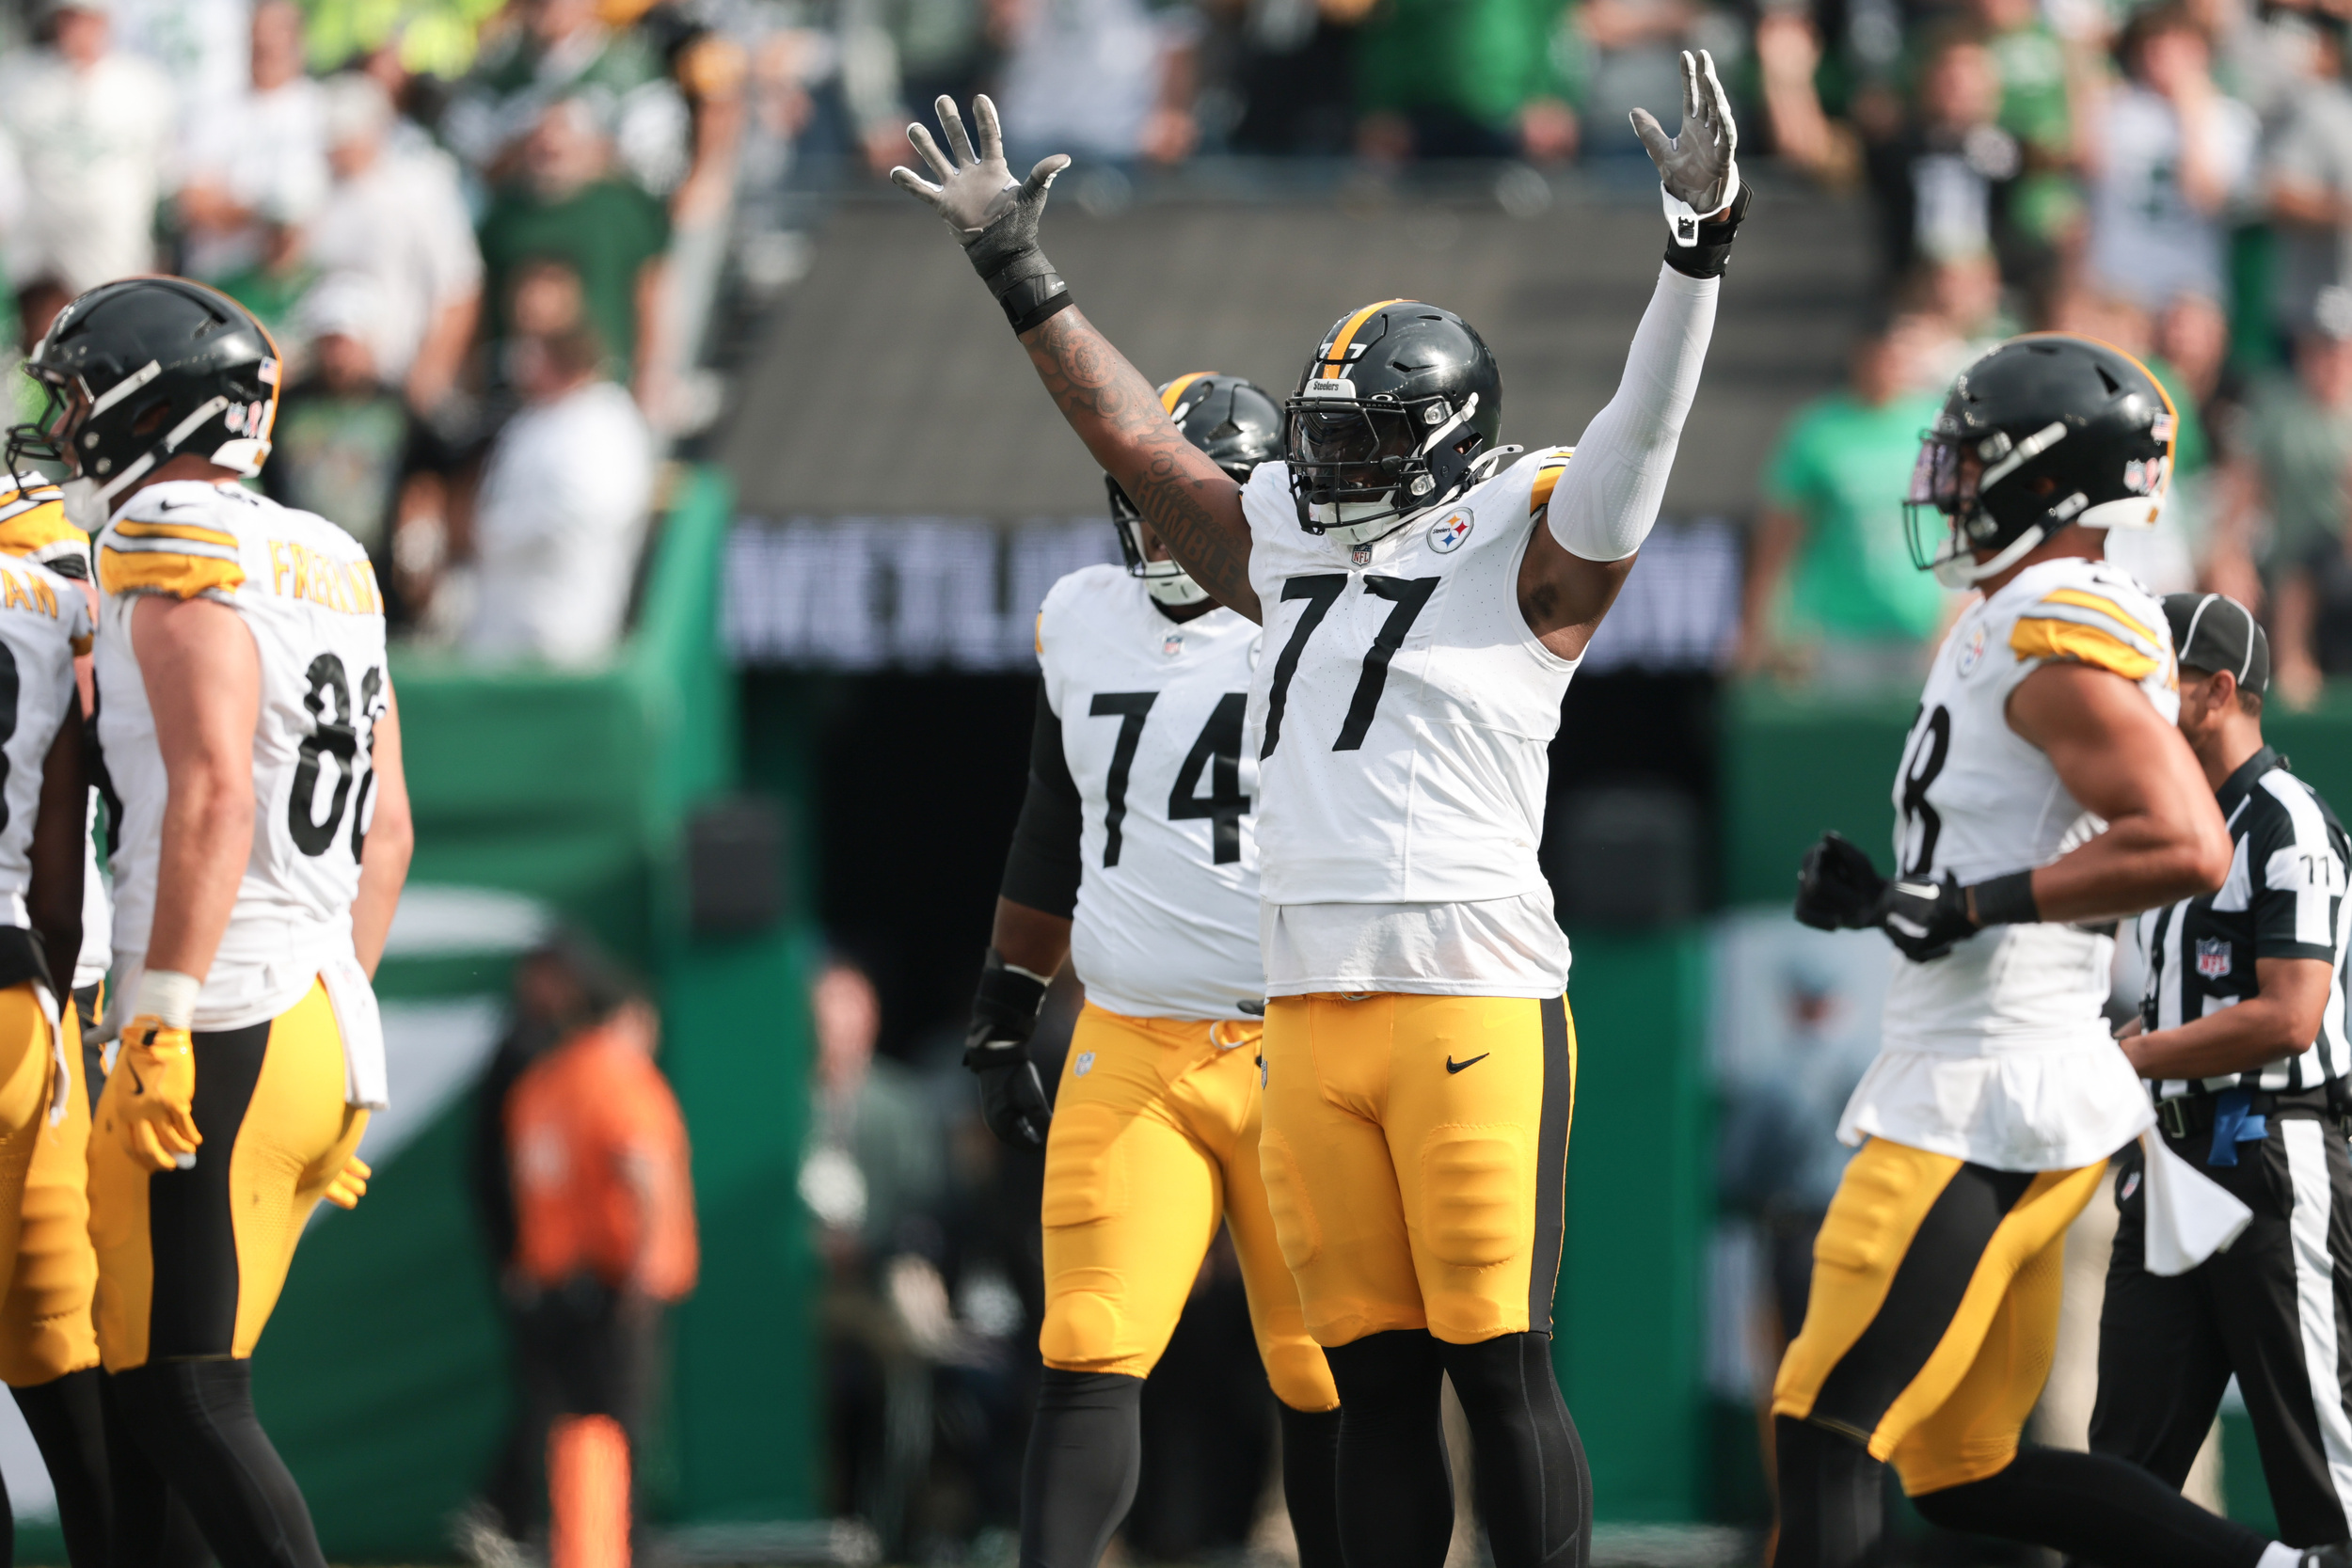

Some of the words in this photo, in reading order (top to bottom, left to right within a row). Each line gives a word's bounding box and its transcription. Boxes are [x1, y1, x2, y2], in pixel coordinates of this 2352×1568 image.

[1312, 381, 1340, 391] Steelers
[1134, 476, 1240, 594] HUMBLE
[1353, 551, 1369, 563] NFL
[1260, 574, 1441, 762] 77
[1089, 690, 1251, 869] 74
[2200, 954, 2228, 974] NFL
